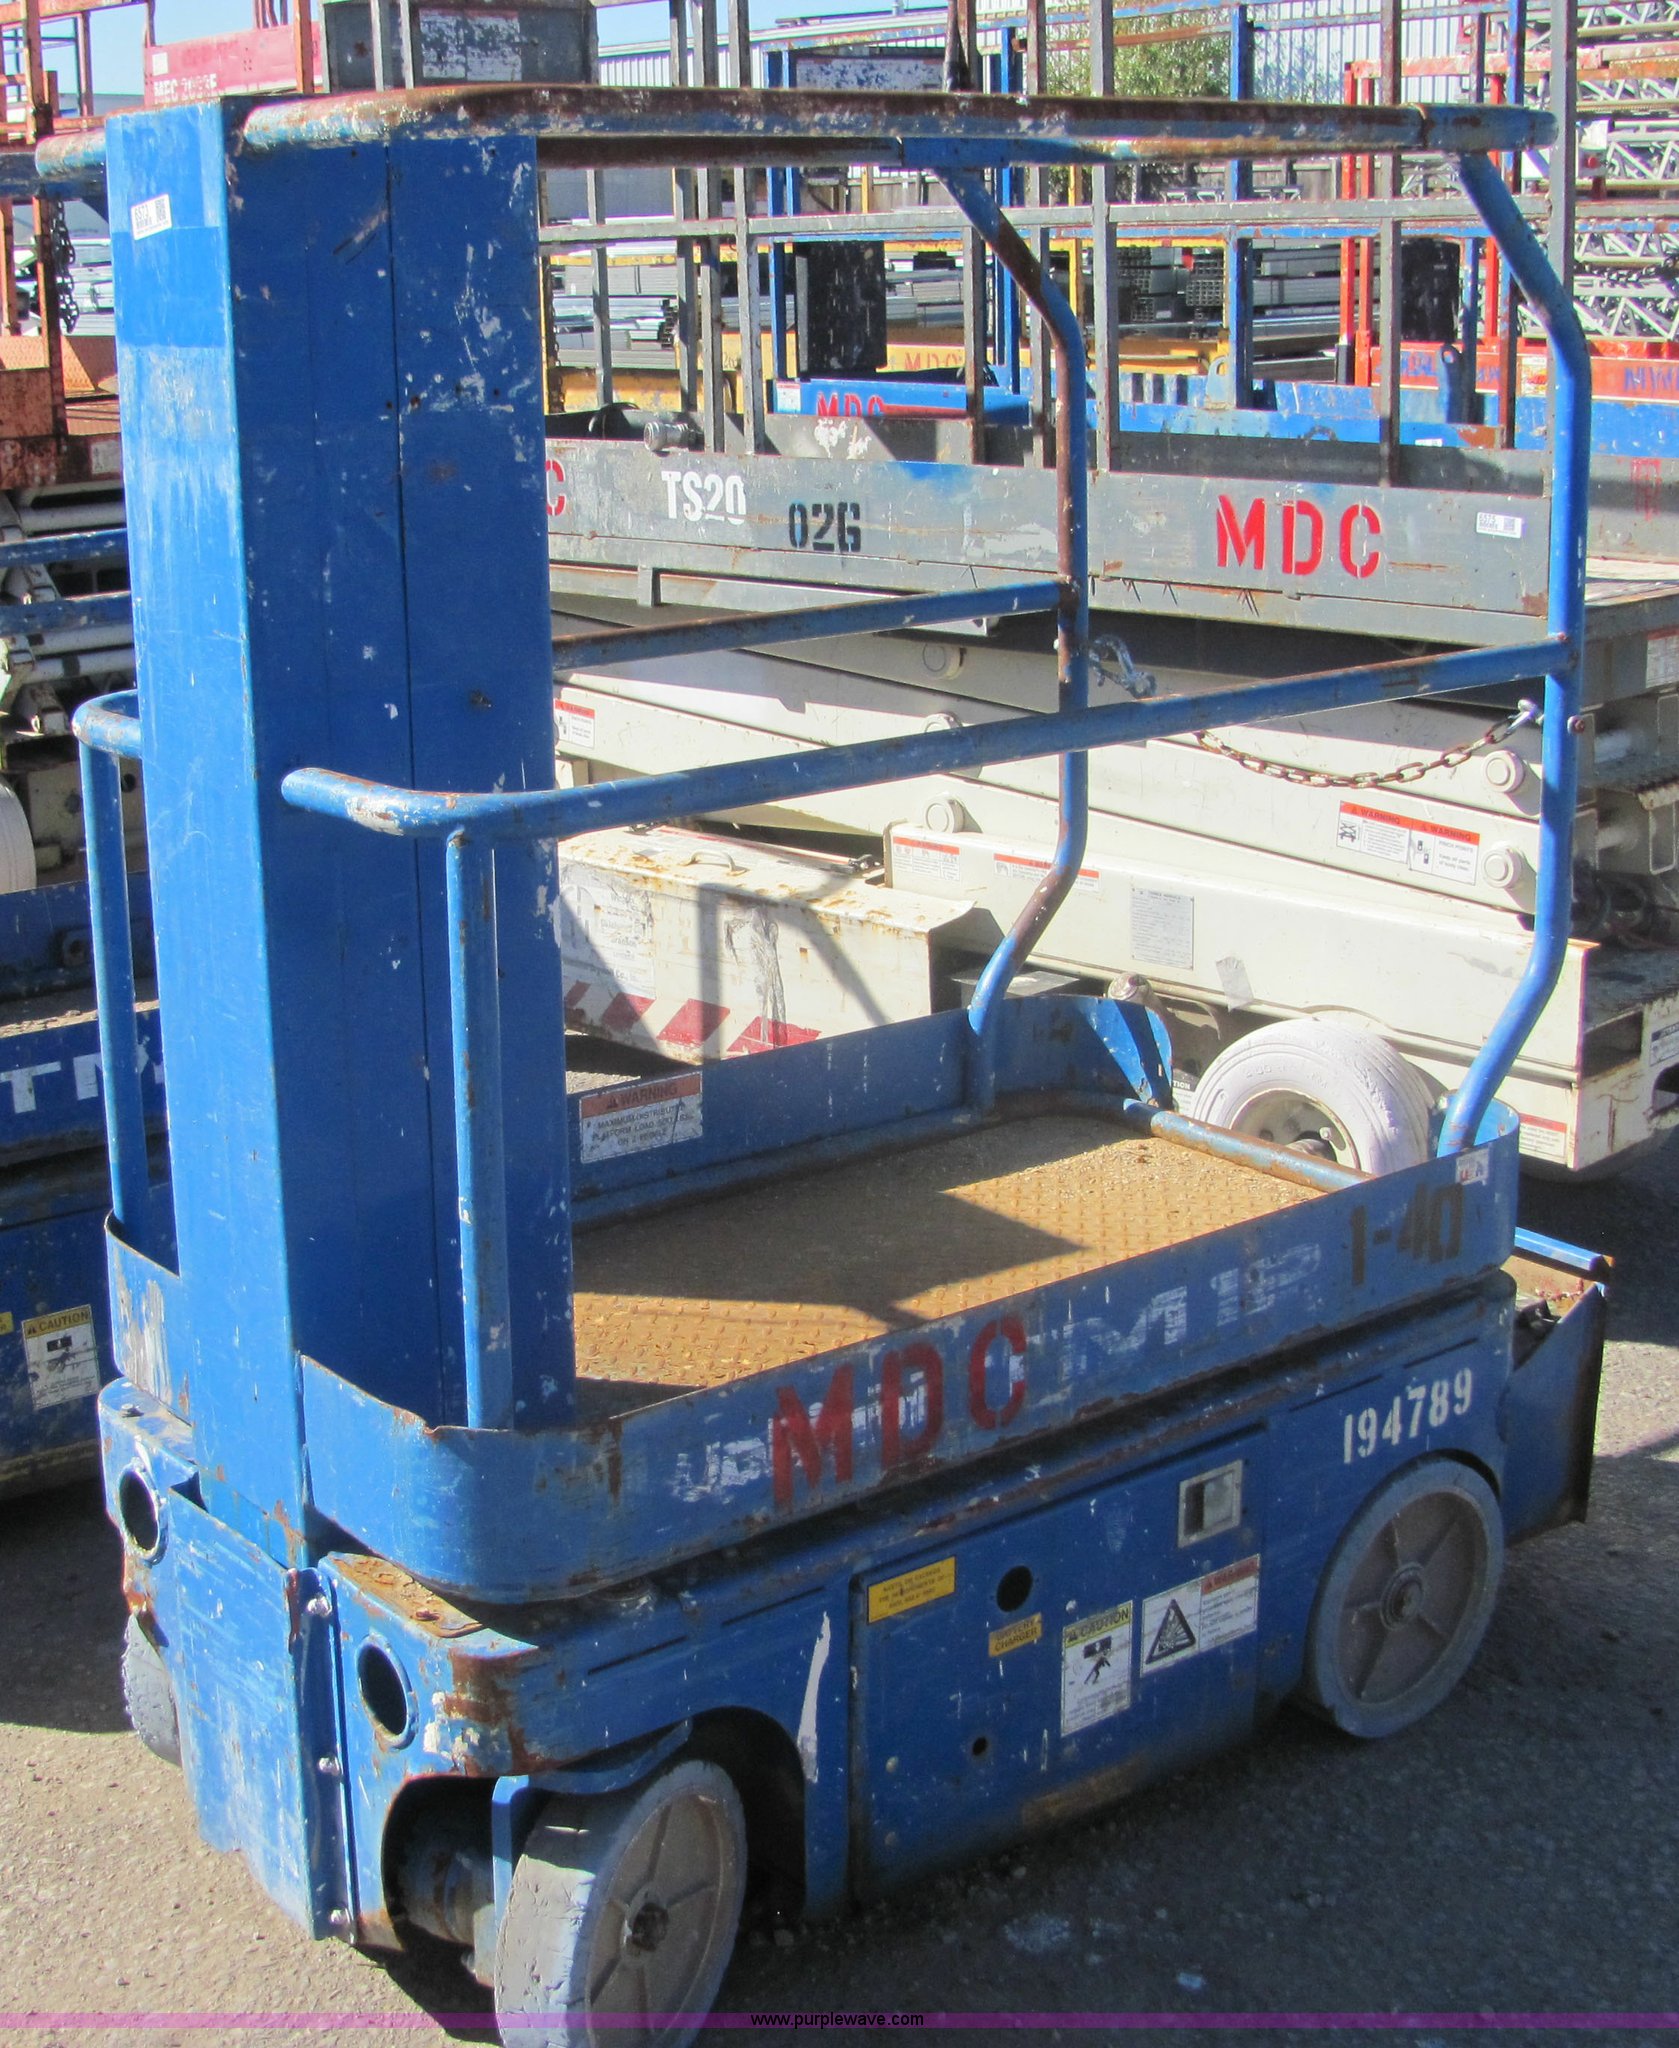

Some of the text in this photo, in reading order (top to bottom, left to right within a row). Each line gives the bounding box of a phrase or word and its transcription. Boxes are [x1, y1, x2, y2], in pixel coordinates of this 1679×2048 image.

[661, 471, 747, 525] TS20
[1216, 494, 1381, 579] MDC
[1360, 808, 1400, 825] WARNING
[1430, 825, 1471, 842] WARNING
[620, 1083, 678, 1105] WARNING
[39, 1311, 89, 1332] CAUTION
[773, 1316, 1027, 1512] MDC
[1343, 1367, 1472, 1464] 194789
[1081, 1607, 1129, 1637] CAUTION
[995, 1627, 1038, 1652] CHARGER
